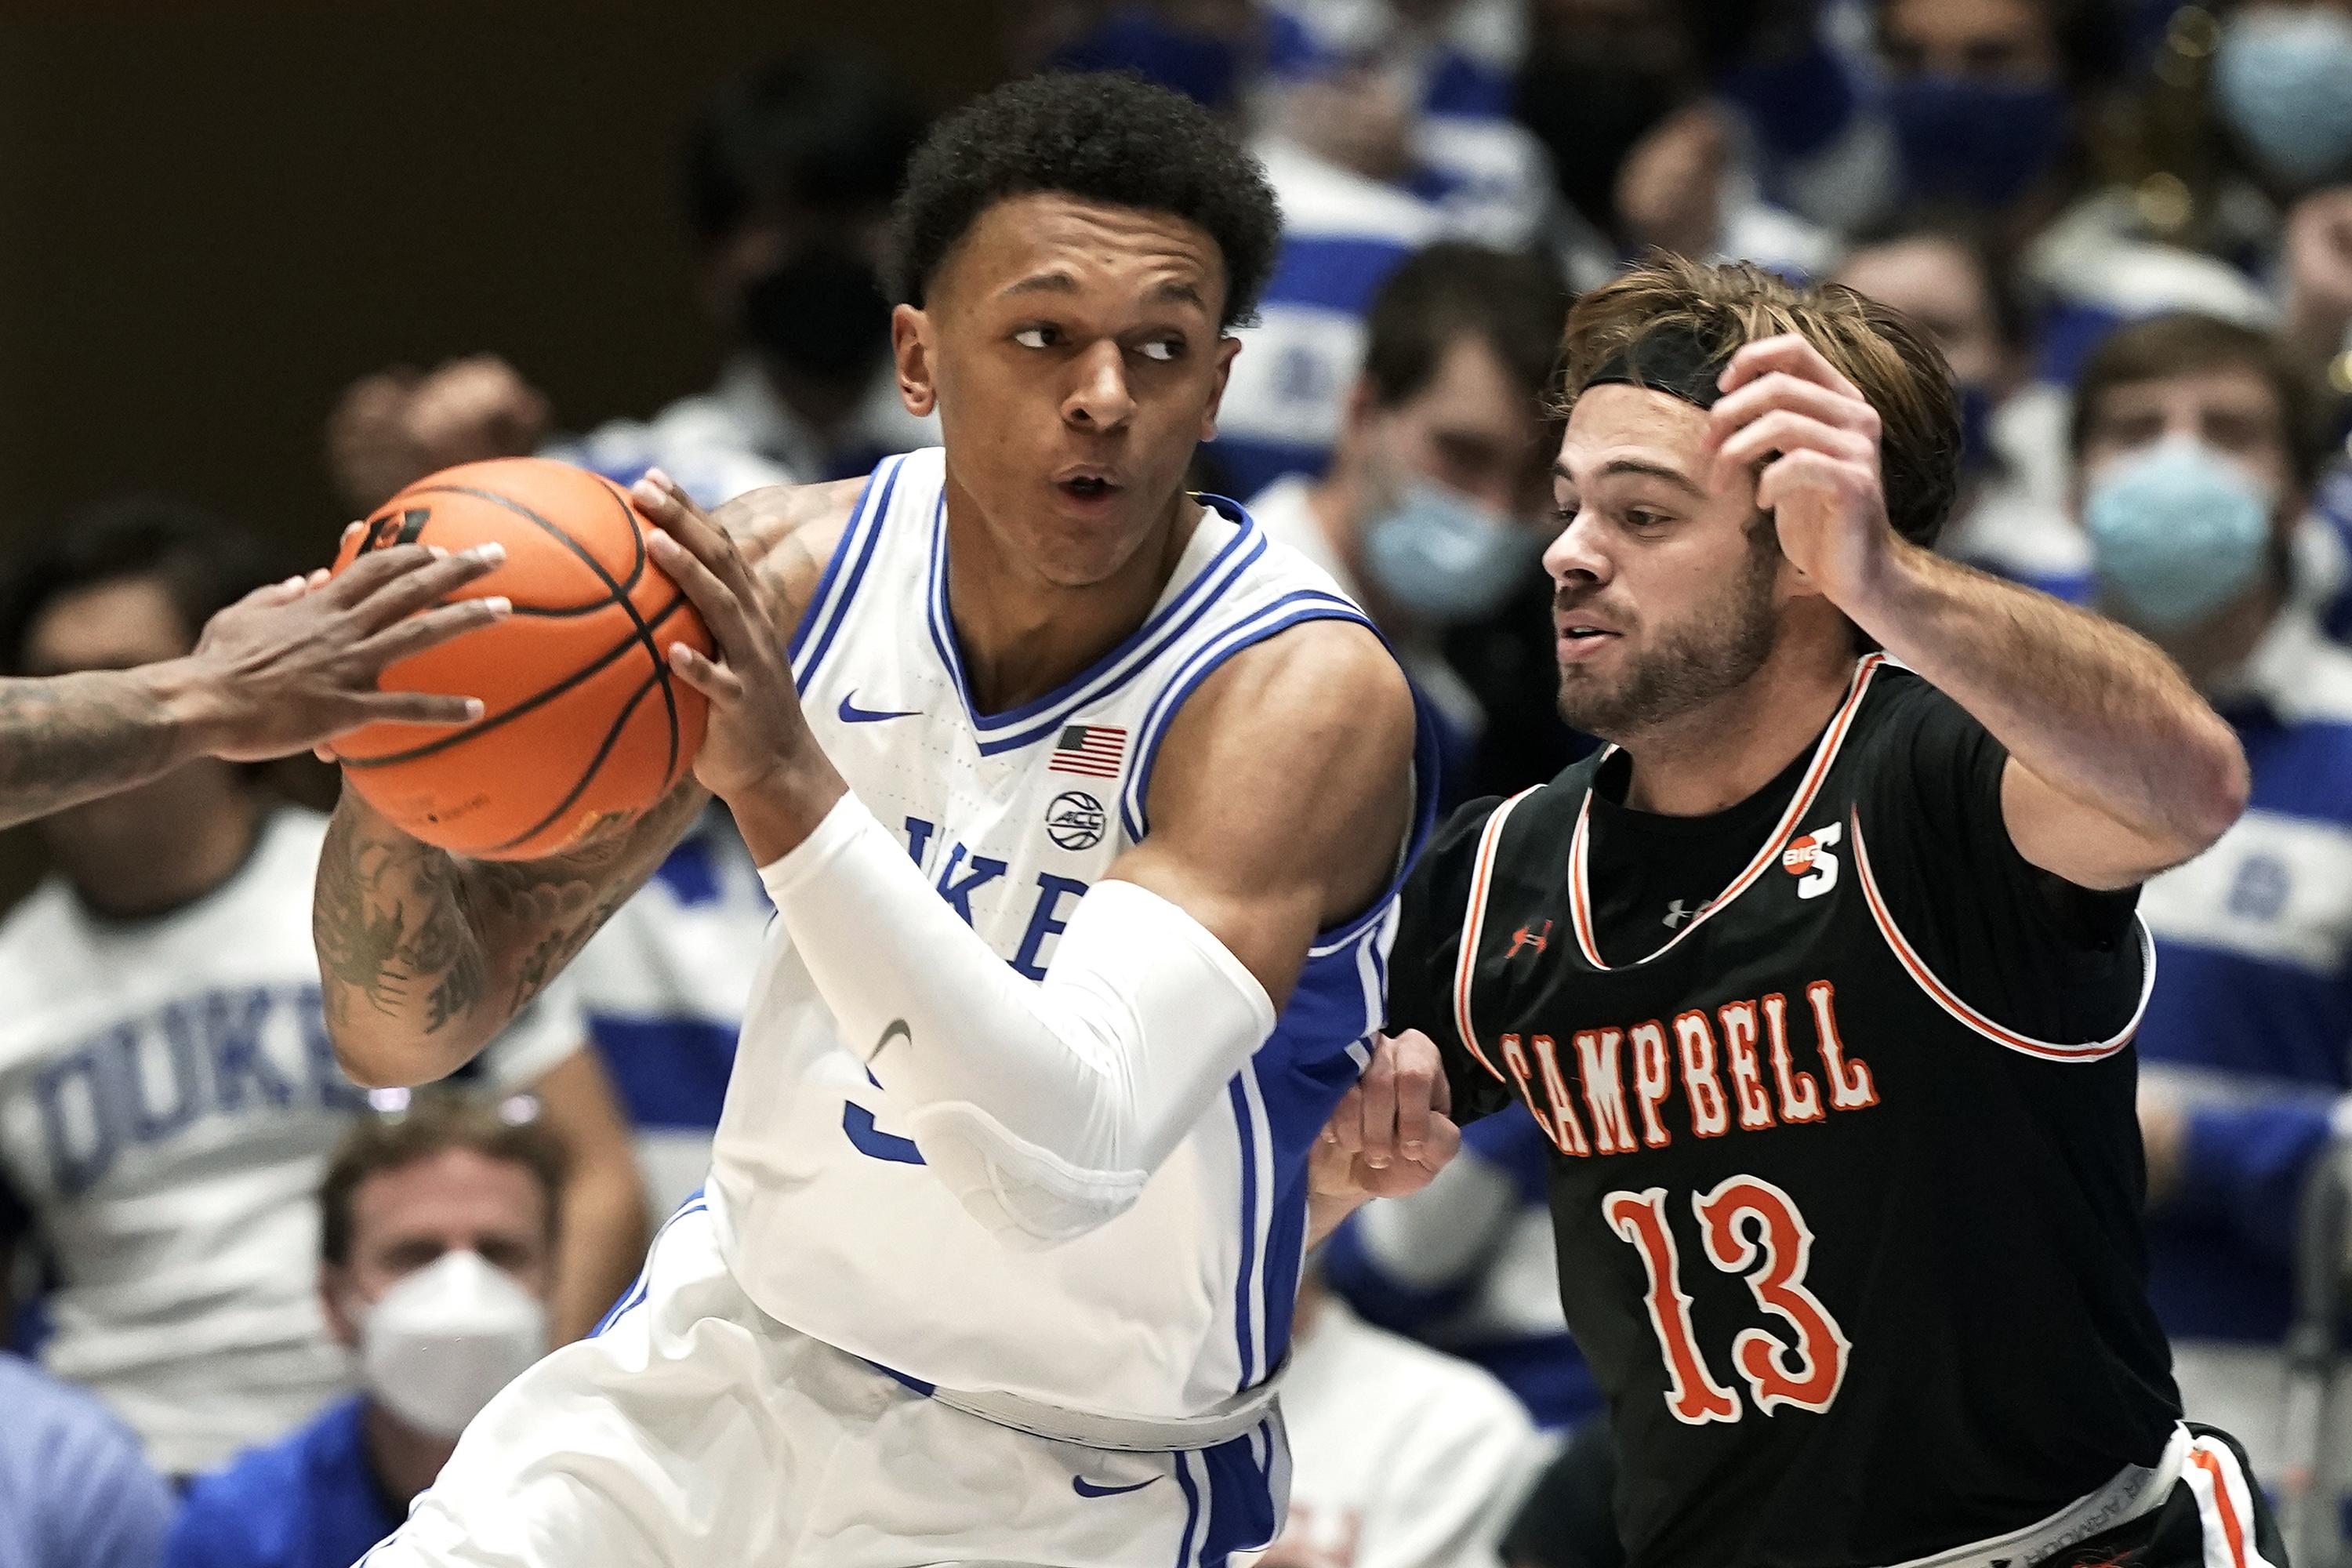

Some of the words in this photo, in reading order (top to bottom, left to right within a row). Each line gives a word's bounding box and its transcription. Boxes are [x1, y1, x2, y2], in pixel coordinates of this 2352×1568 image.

[905, 815, 1089, 982] KE
[1499, 979, 1880, 1157] CAMPBELL
[1602, 1174, 1853, 1425] 13
